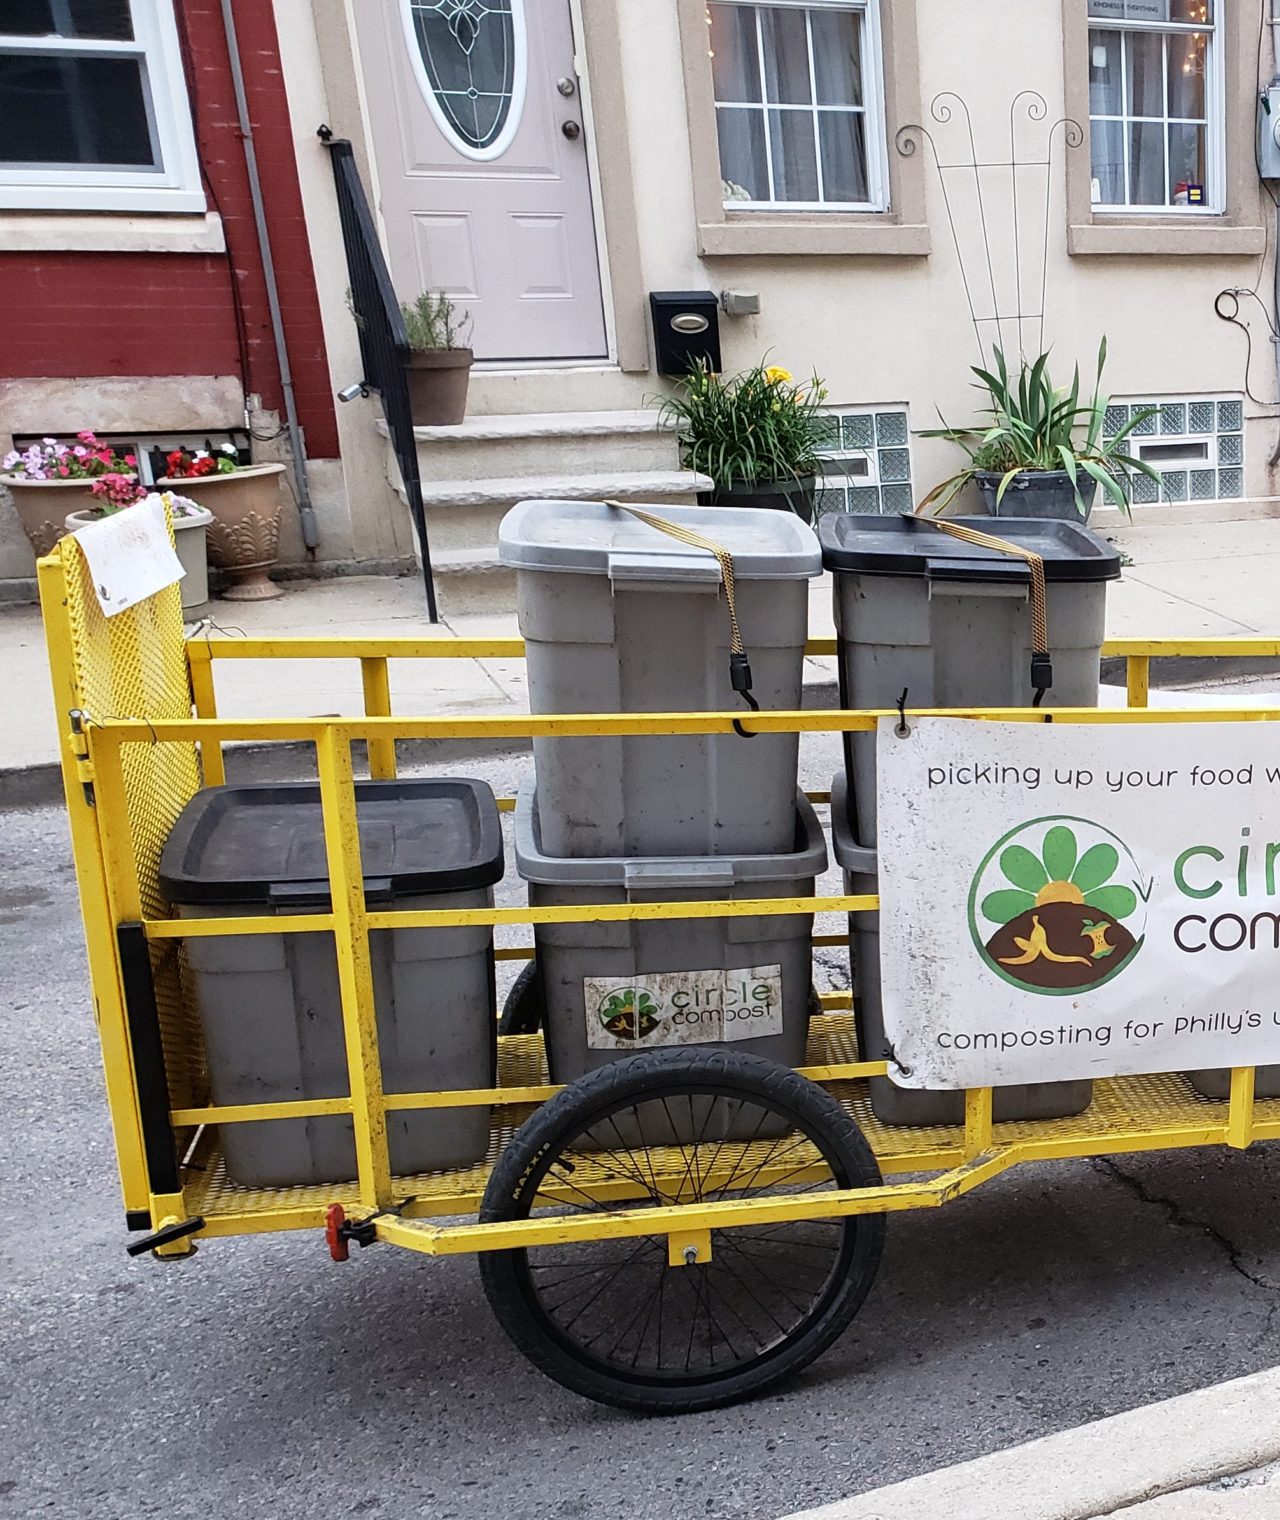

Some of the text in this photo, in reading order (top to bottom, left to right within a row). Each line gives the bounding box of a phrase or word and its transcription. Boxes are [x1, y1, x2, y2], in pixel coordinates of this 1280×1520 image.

[928, 762, 1041, 790] picking
[1054, 768, 1093, 789] up
[1106, 770, 1178, 793] your
[1189, 763, 1253, 786] food
[671, 981, 771, 1009] circle
[671, 1002, 772, 1026] compost
[937, 1024, 1112, 1052] composting
[1123, 1019, 1164, 1039] for
[1174, 1009, 1262, 1035] Philly's
[511, 1142, 551, 1200] MAXXIS
